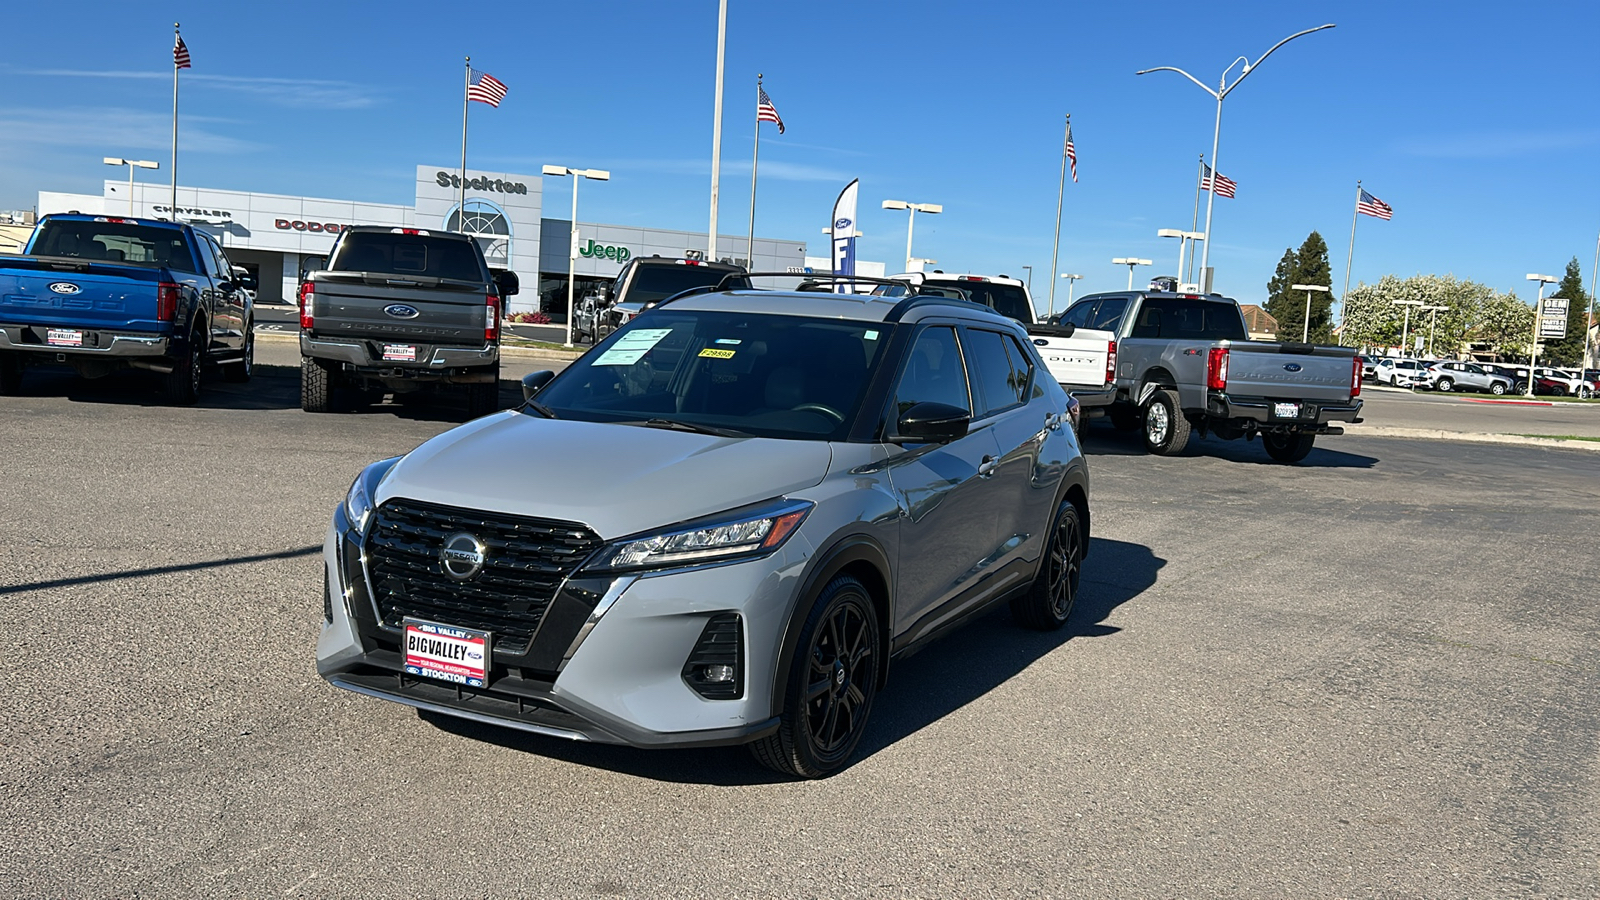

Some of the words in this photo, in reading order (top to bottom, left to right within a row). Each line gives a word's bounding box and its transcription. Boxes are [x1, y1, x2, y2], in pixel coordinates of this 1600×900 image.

[436, 171, 527, 195] Stockton
[152, 205, 232, 218] CHRYSLER
[579, 239, 631, 263] Jeep
[53, 282, 78, 294] Ford
[1544, 300, 1567, 308] OEM
[410, 326, 461, 336] DUTY
[1049, 356, 1097, 364] DUTY
[445, 550, 479, 563] NISSAN
[422, 624, 436, 633] BIG
[438, 627, 466, 639] VALLEY
[408, 635, 468, 661] BIGVALLEY
[421, 667, 467, 684] STOCKTON
